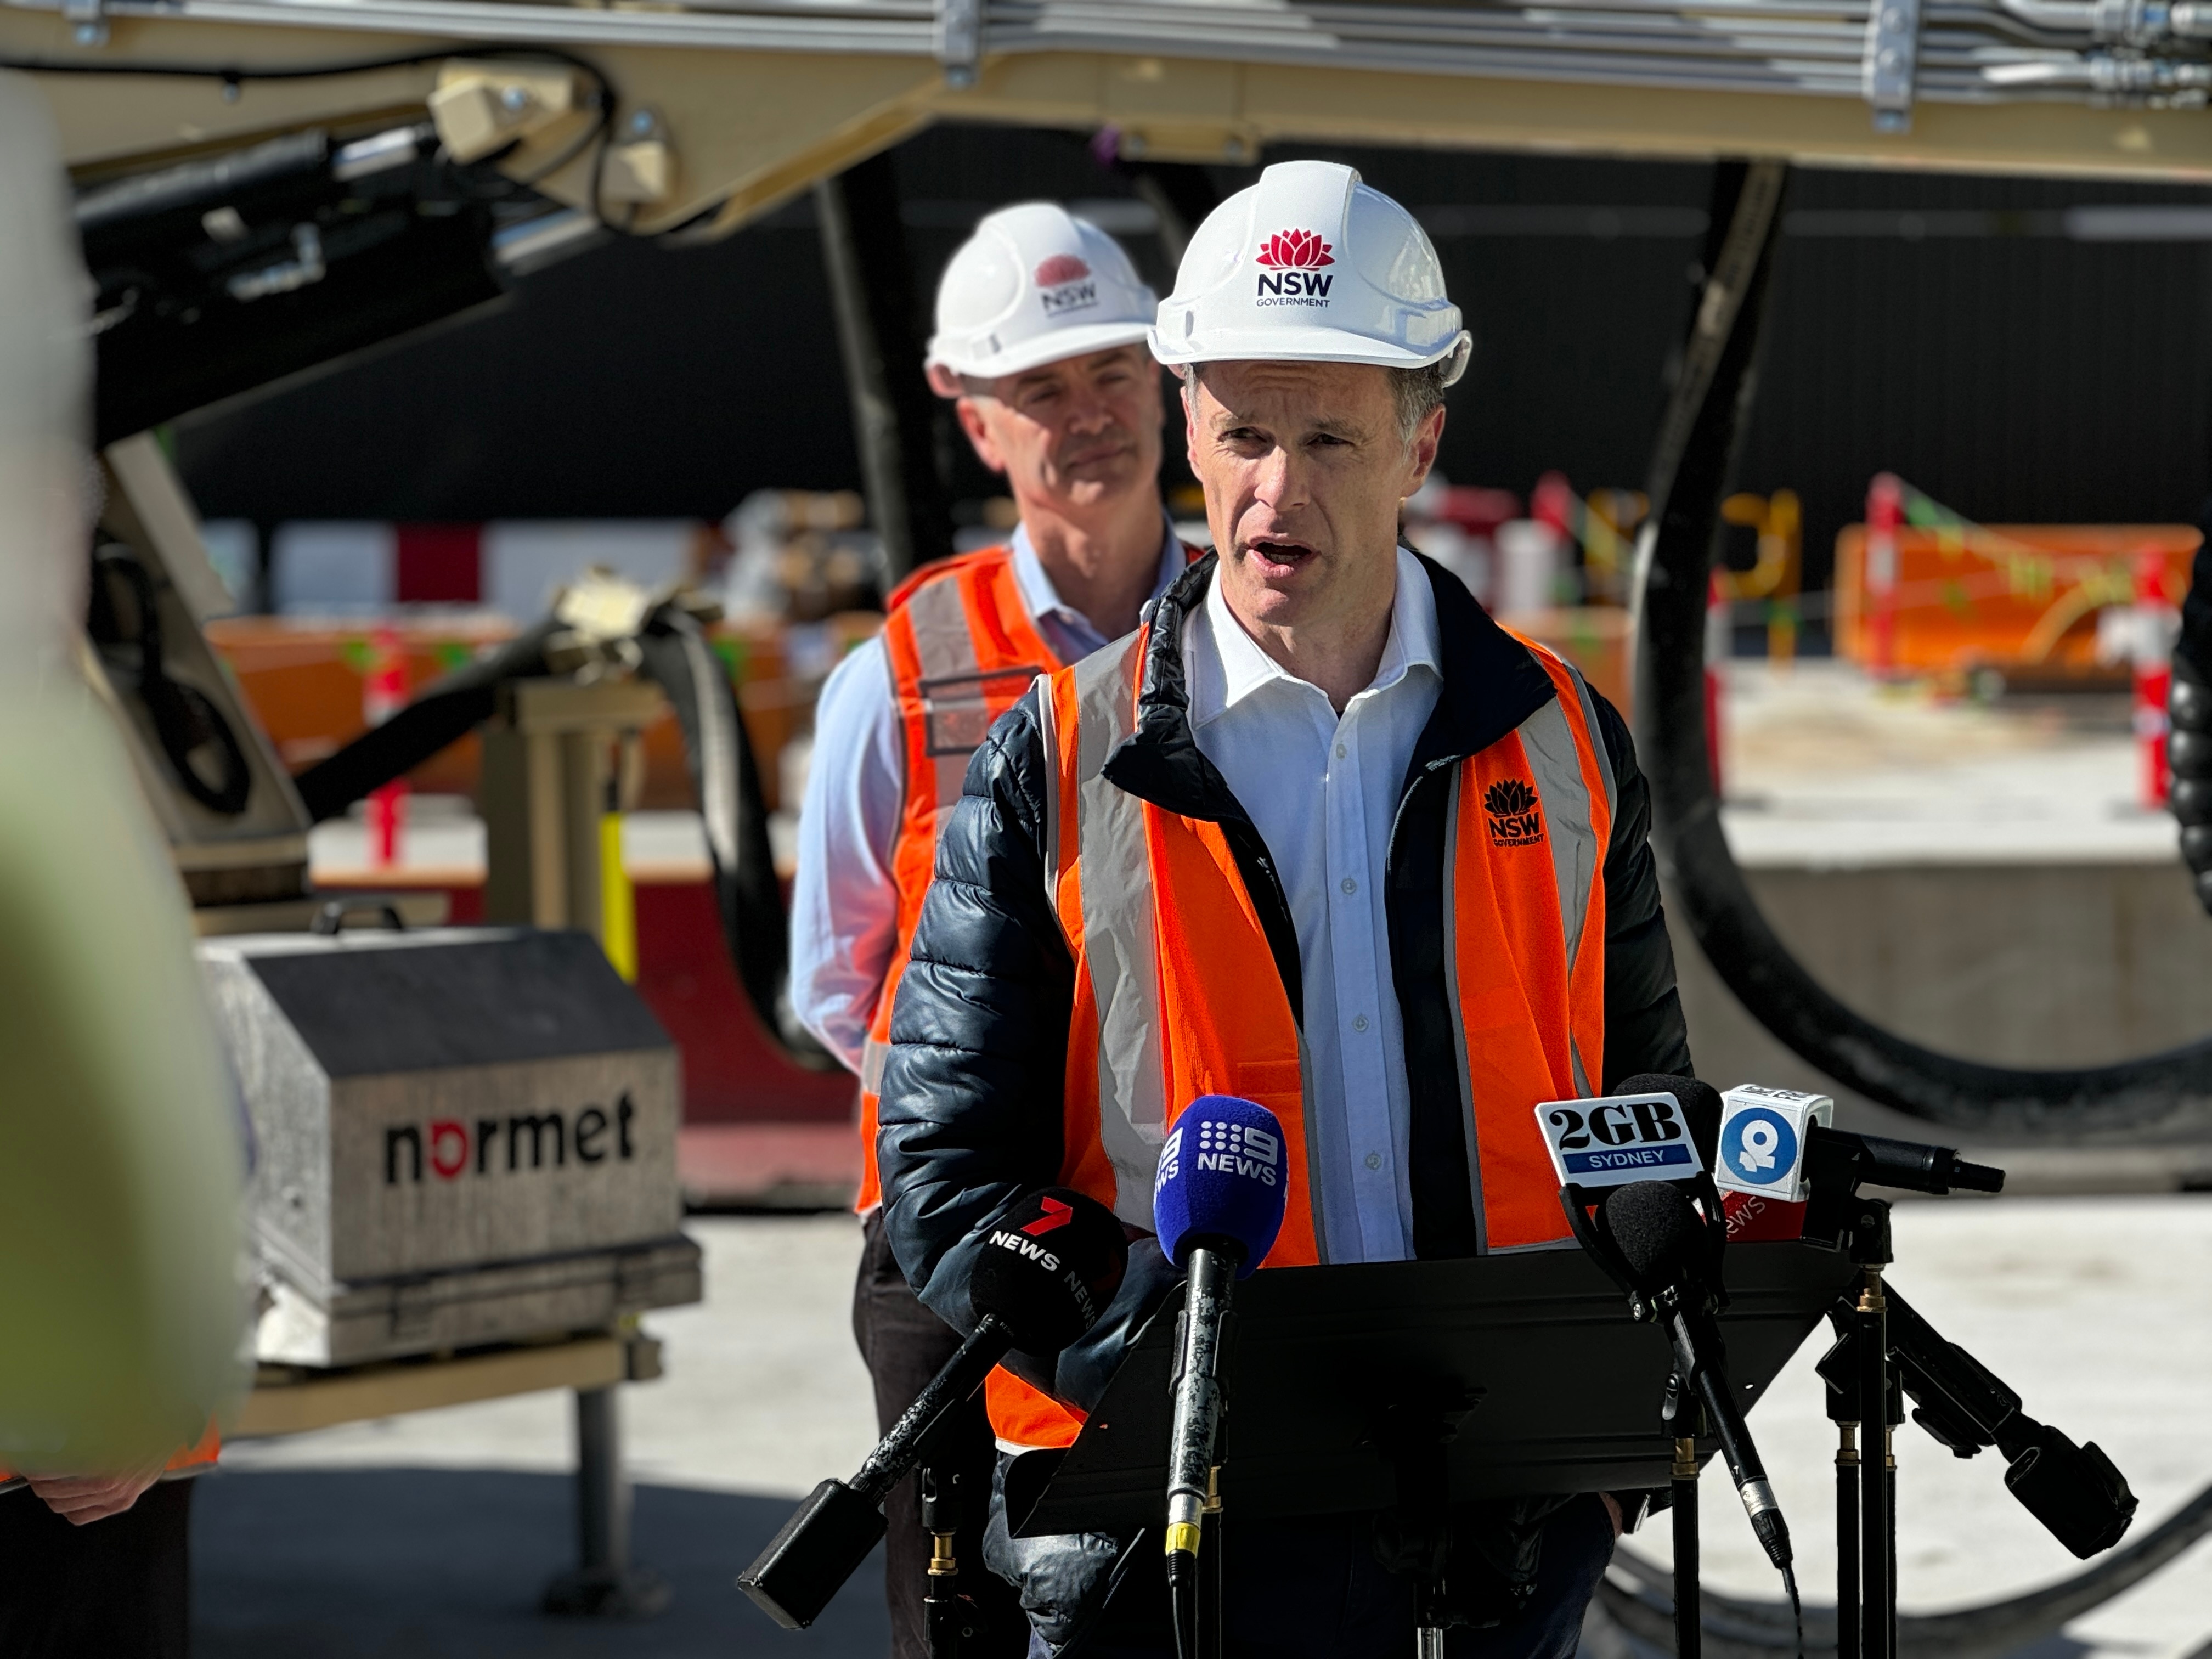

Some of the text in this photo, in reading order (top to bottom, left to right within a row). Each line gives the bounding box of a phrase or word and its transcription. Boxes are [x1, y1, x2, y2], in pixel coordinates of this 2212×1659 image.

[1041, 283, 1096, 312] NSW
[1256, 297, 1330, 308] GOVERNMENT
[1257, 272, 1334, 297] NSW
[1488, 811, 1539, 838] NSW
[1493, 833, 1544, 847] GOVERNMENT
[386, 1093, 634, 1185] normet
[1549, 1102, 1682, 1151] 2GB
[1243, 1126, 1278, 1166] 9
[1588, 1149, 1664, 1169] SYDNEY
[1198, 1153, 1277, 1186] NEWS
[1020, 1196, 1073, 1237] 7
[1726, 1195, 1765, 1238] ews
[989, 1231, 1060, 1271] NEWS
[1064, 1270, 1096, 1330] NEWS
